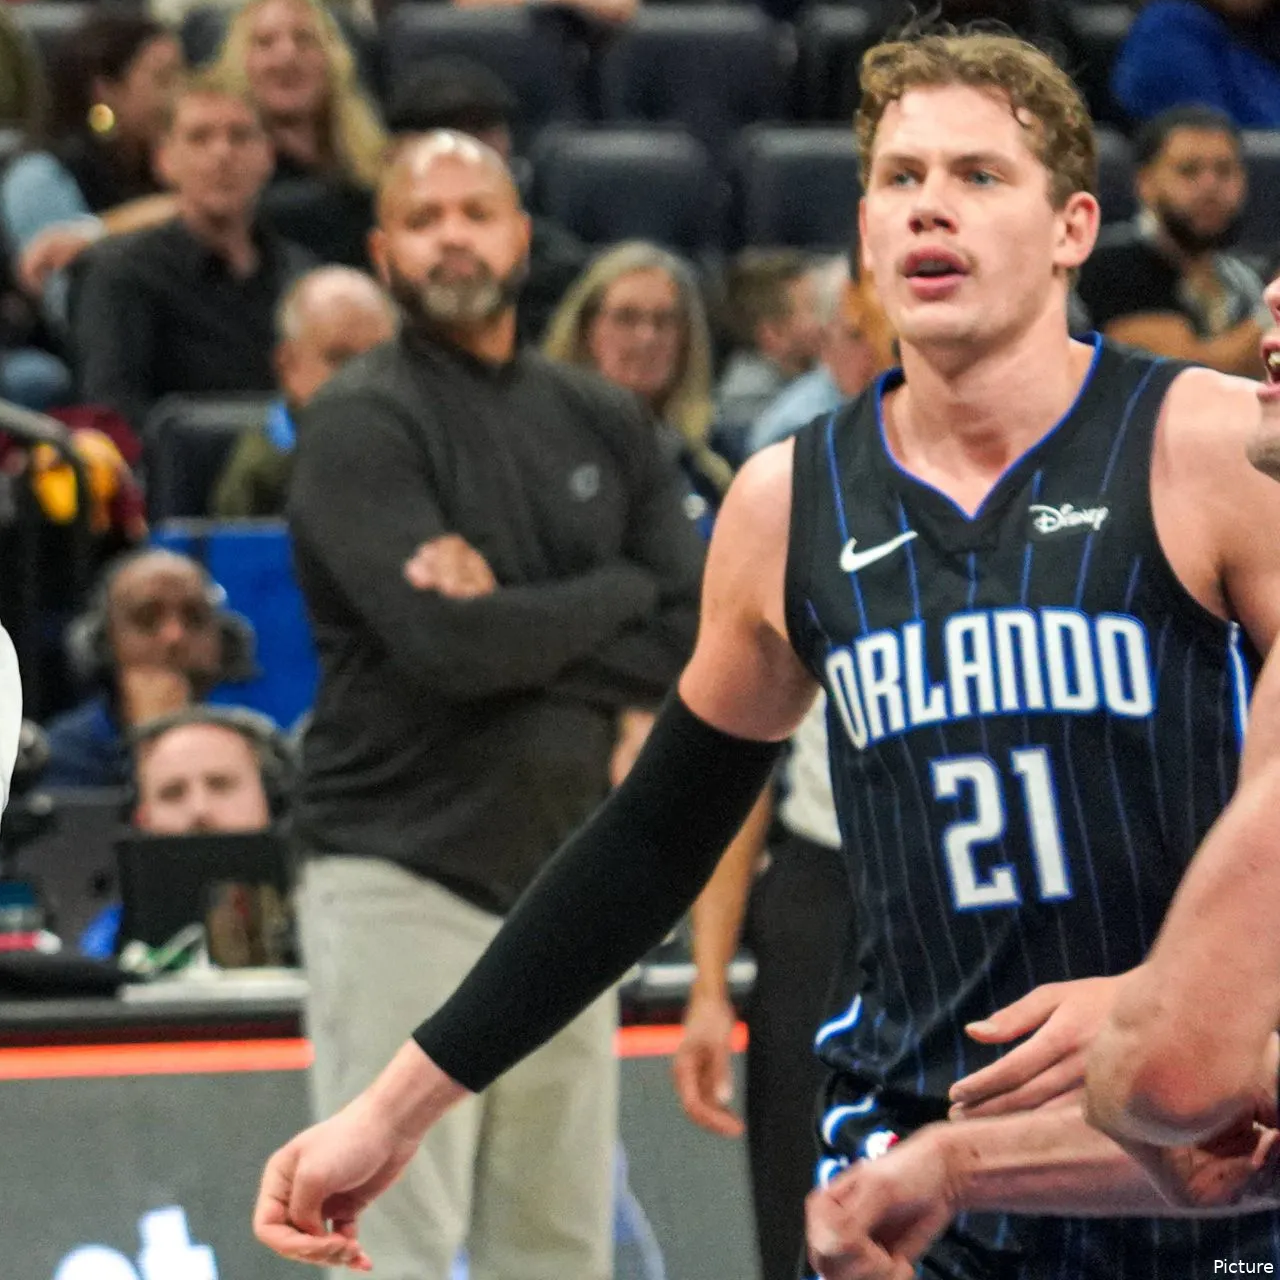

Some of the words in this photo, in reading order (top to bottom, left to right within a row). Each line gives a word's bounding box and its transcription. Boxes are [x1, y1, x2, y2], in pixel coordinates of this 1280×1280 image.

[1028, 503, 1109, 535] Disney
[824, 605, 1154, 751] ORLANDO
[931, 746, 1073, 911] 21
